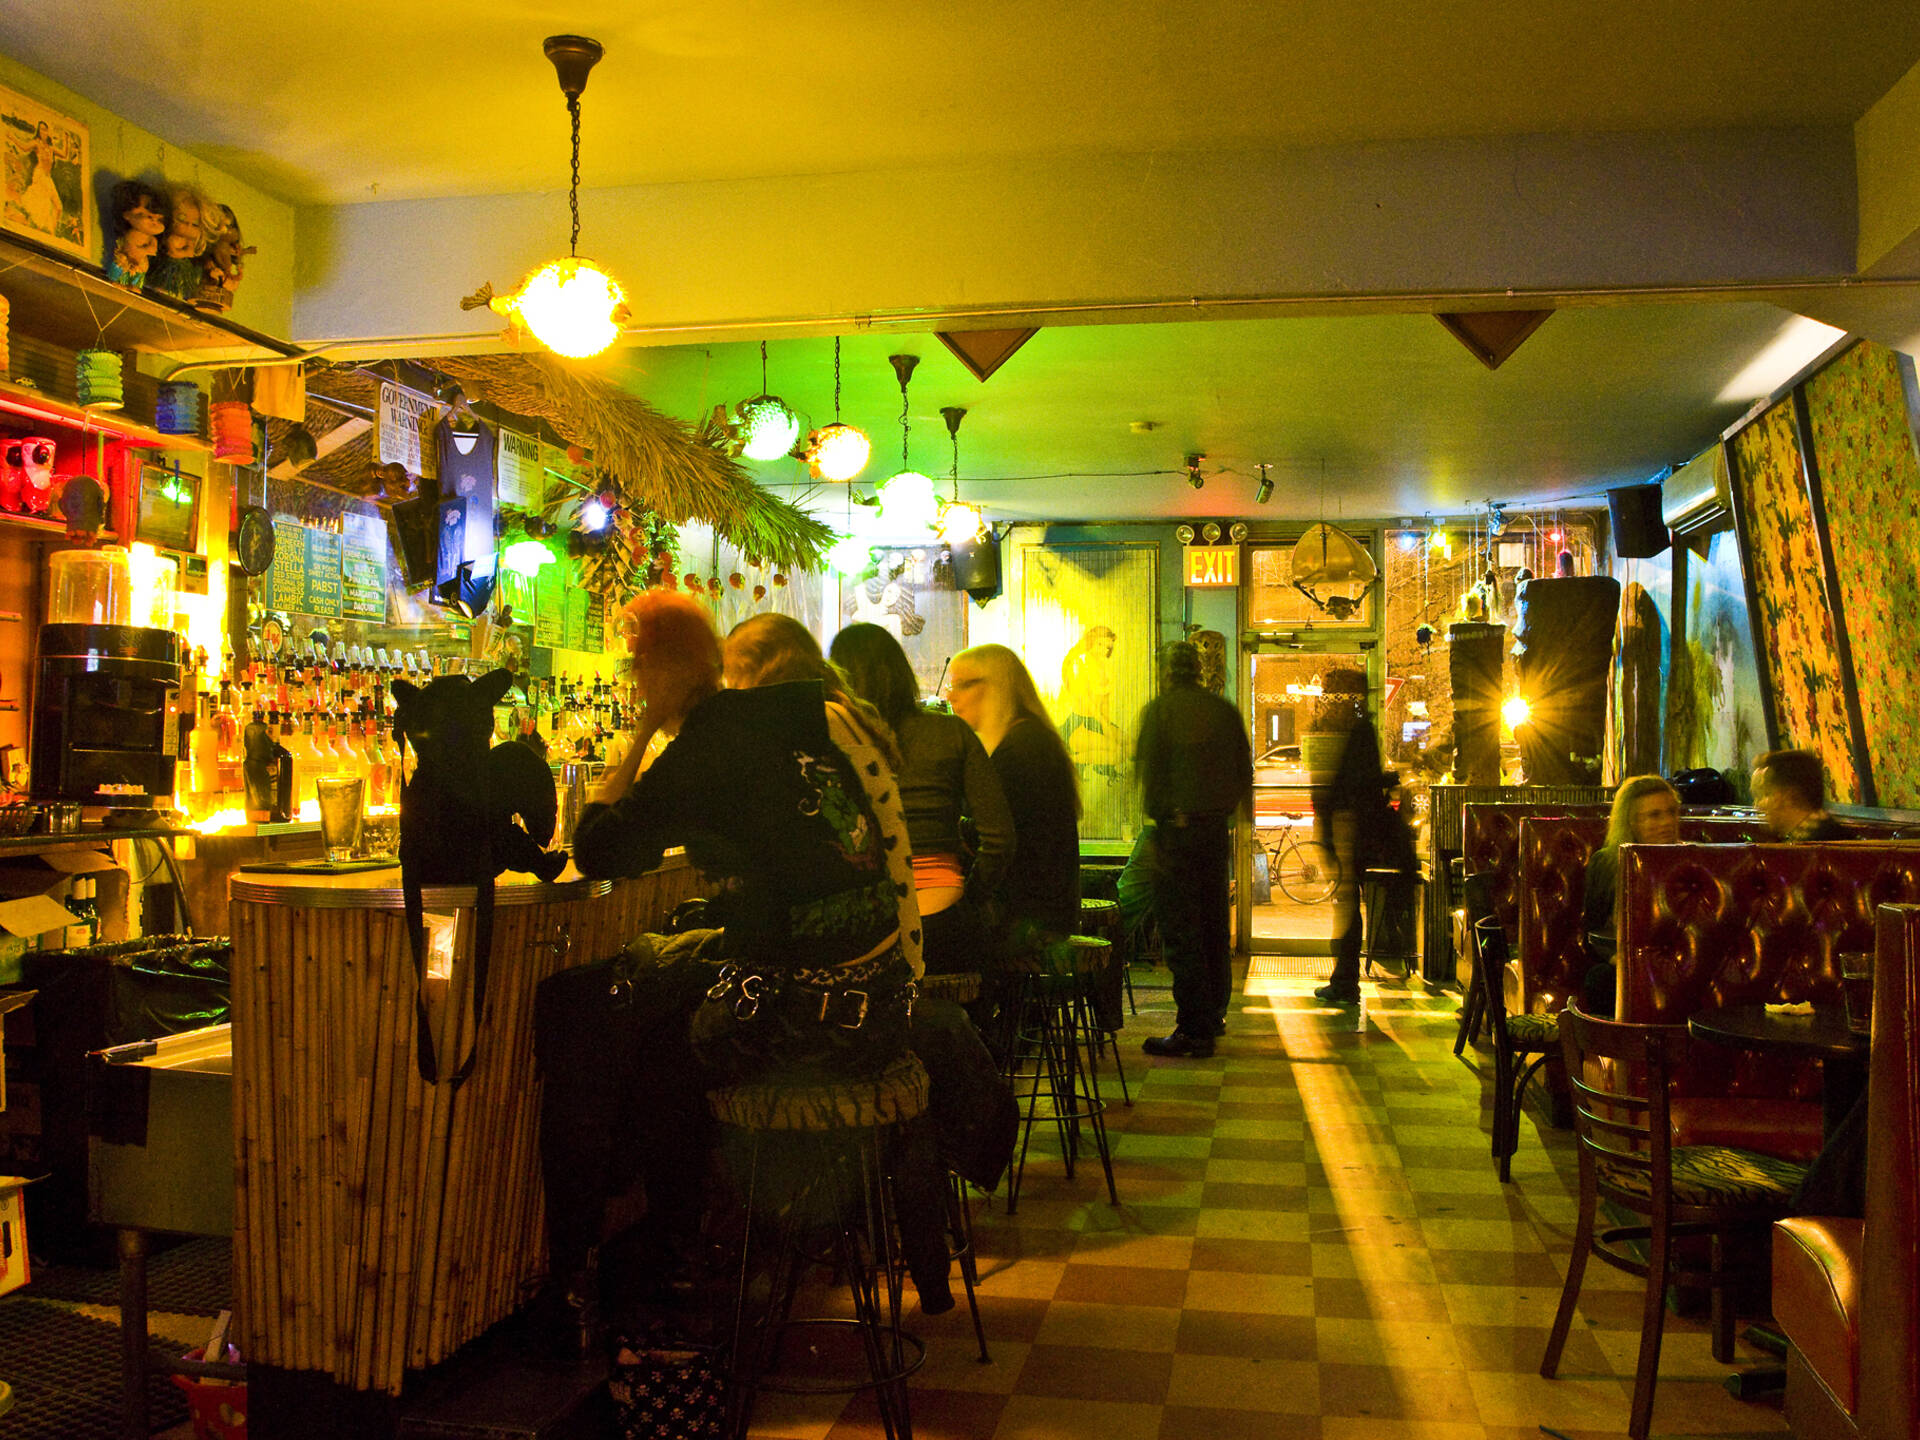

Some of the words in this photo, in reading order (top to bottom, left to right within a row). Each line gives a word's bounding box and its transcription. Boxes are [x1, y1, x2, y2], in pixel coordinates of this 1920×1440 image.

[382, 386, 438, 421] GOVERNMENT
[503, 433, 539, 462] WARNING
[274, 551, 305, 564] CORONA
[273, 560, 305, 573] STELLA
[1190, 551, 1235, 583] EXIT
[273, 570, 285, 579] RED
[273, 583, 305, 595] GUINNESS
[311, 579, 339, 594] PABST
[273, 592, 304, 606] LAMBIC
[308, 595, 324, 605] CASH
[324, 597, 340, 607] ONLY
[313, 605, 335, 615] PLEASE
